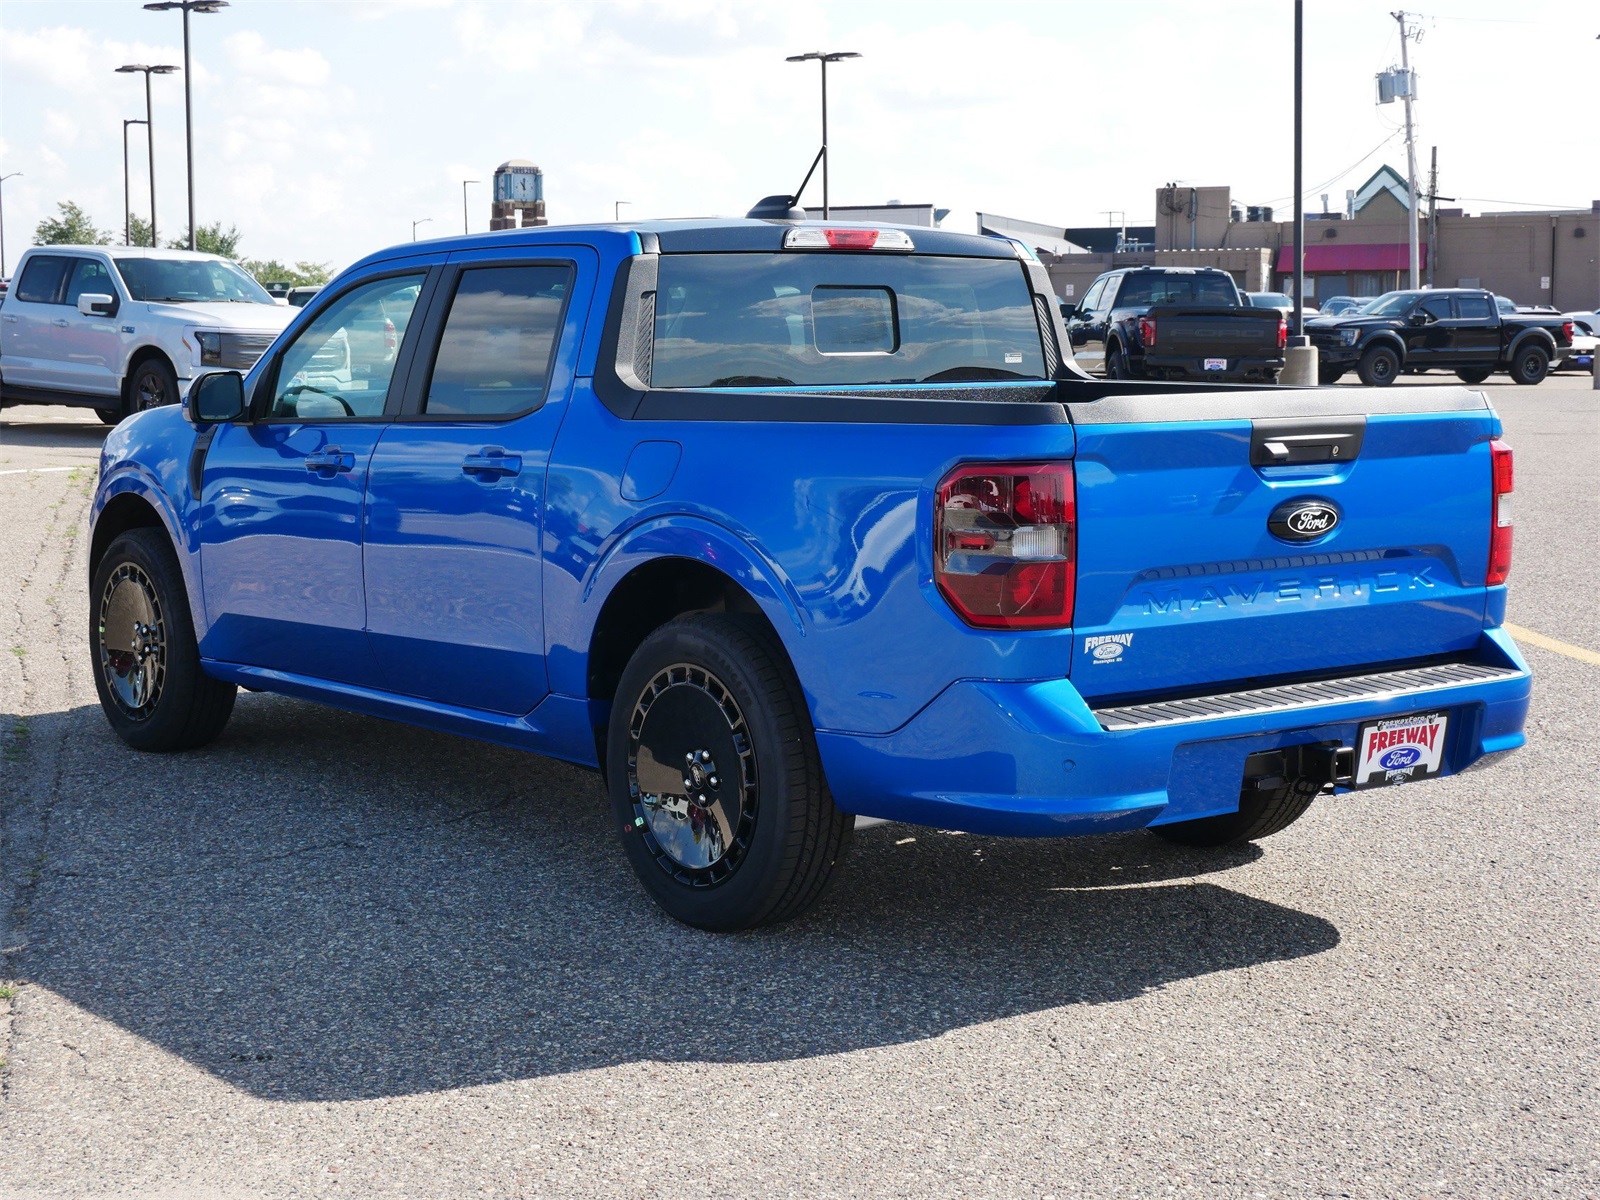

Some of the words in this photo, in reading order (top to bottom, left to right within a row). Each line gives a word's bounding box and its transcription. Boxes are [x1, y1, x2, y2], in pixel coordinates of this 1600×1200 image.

[1297, 510, 1328, 531] Ford
[1143, 566, 1435, 615] MAVERICK
[1084, 633, 1134, 654] FREEWAY
[1366, 724, 1440, 764] FREEWAY
[1387, 750, 1413, 766] Ford
